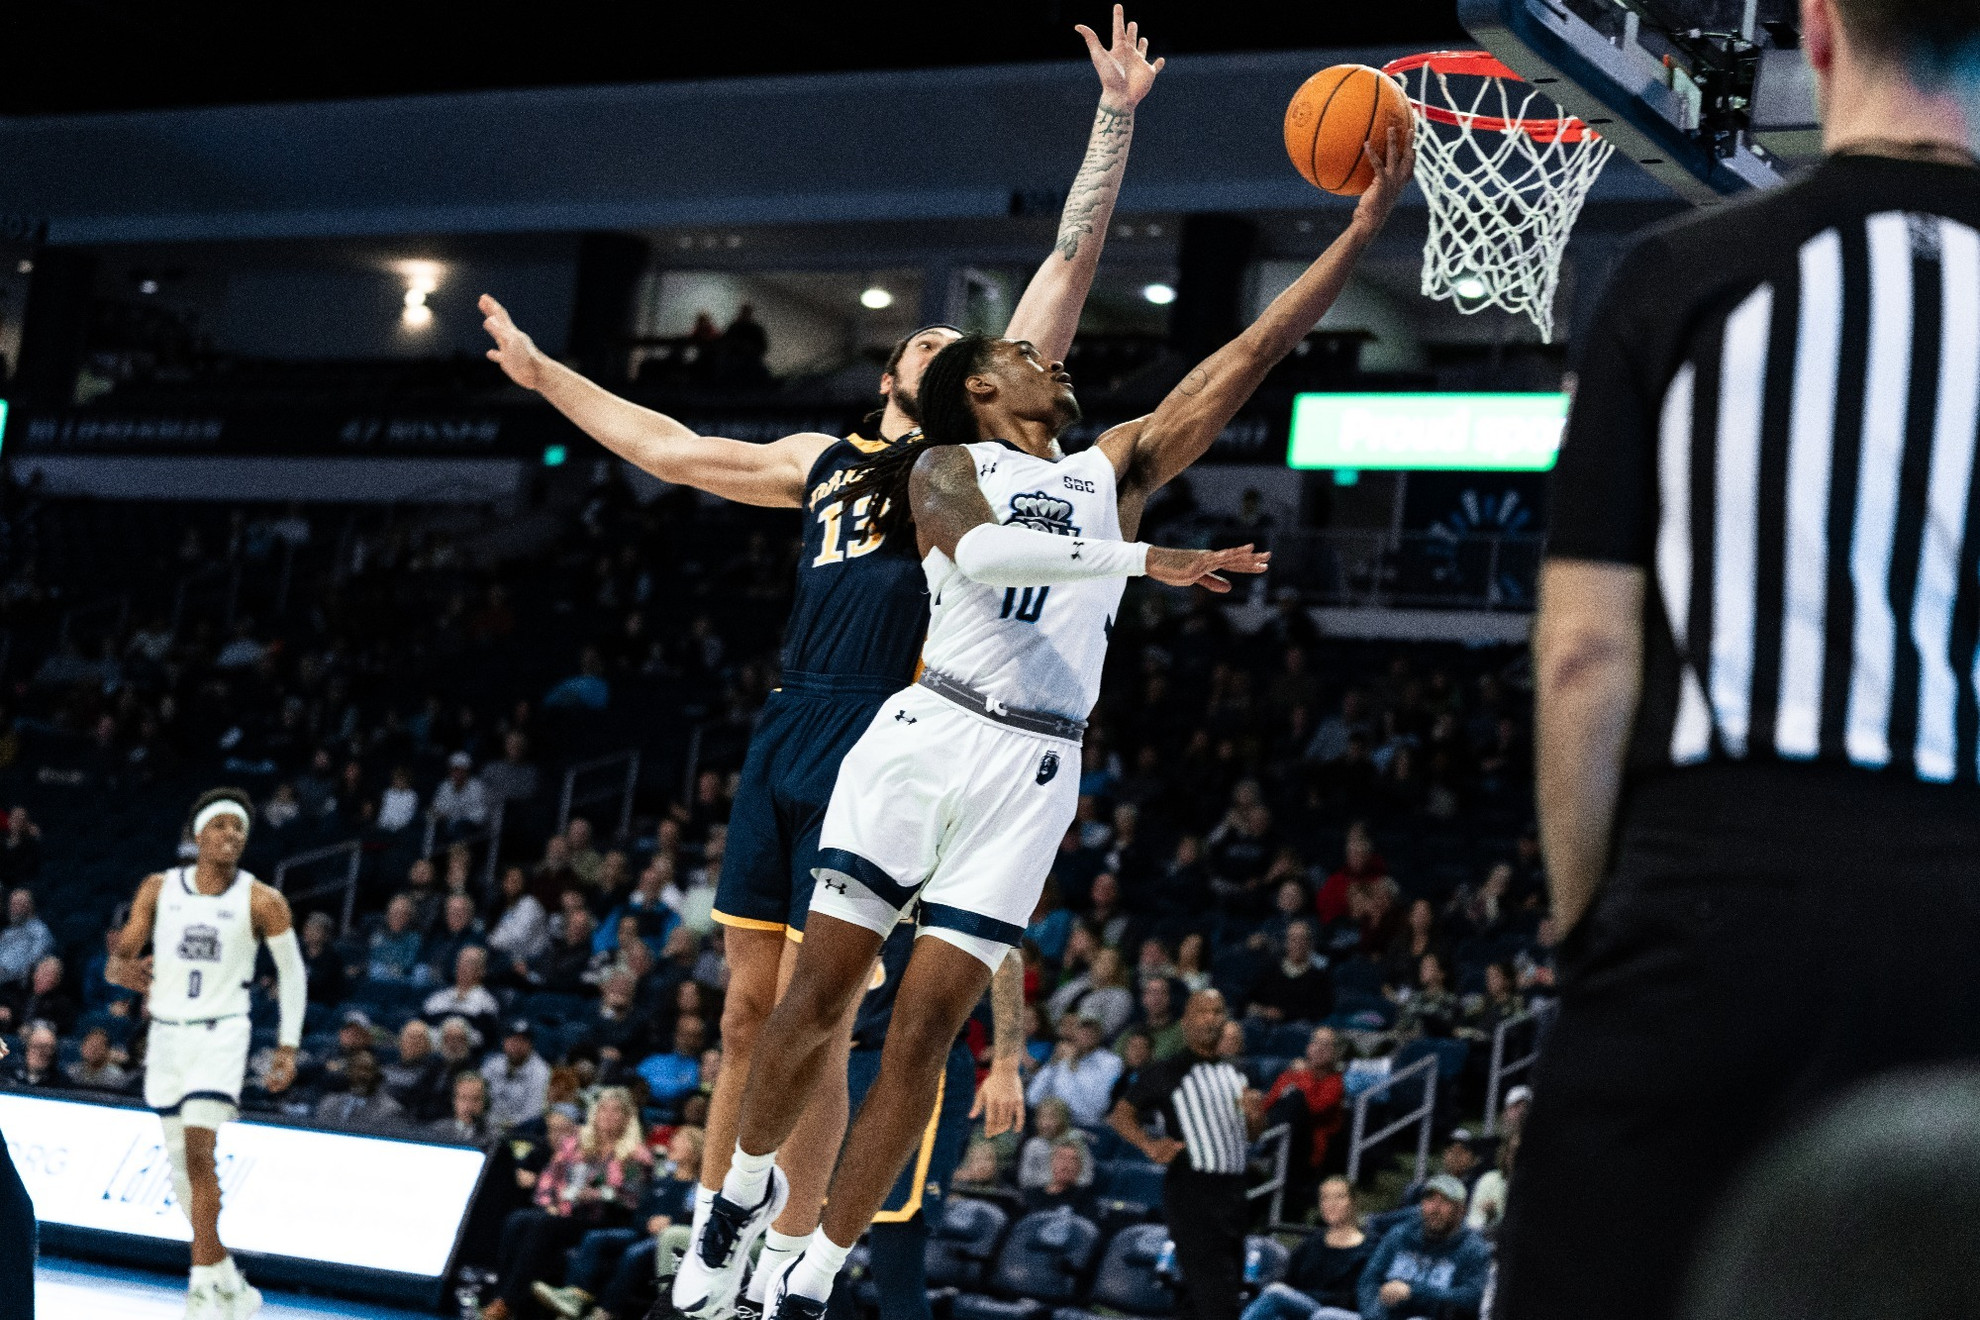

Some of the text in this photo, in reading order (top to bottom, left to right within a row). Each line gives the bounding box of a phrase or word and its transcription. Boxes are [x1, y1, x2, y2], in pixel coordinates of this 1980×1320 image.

[1339, 407, 1470, 452] Proud
[1063, 475, 1095, 494] SBC
[811, 494, 891, 568] 13
